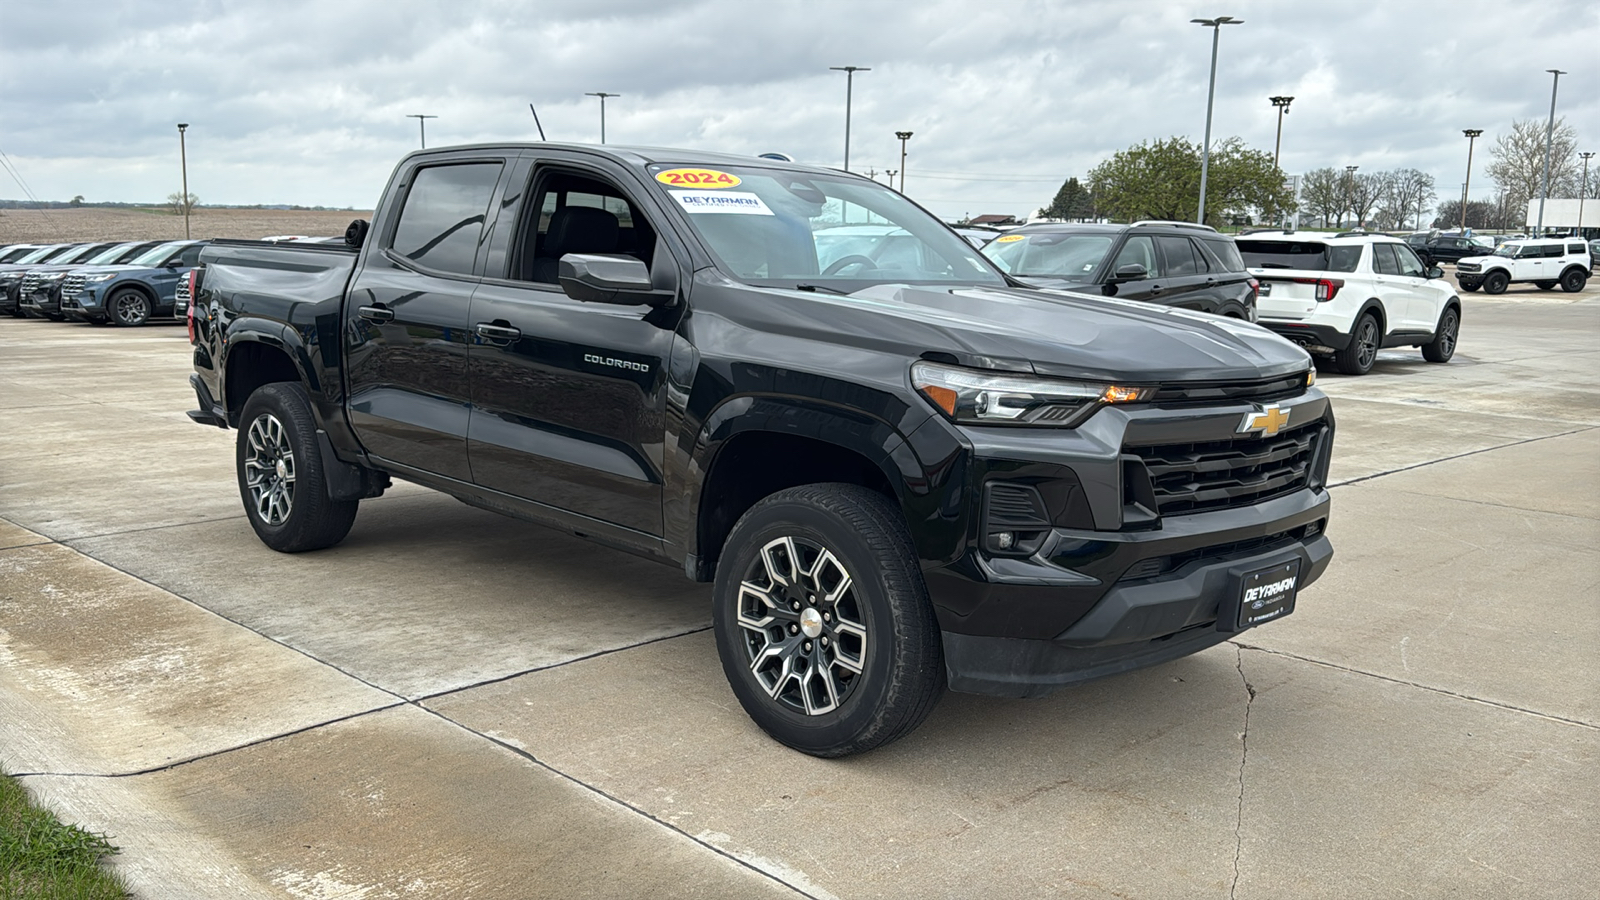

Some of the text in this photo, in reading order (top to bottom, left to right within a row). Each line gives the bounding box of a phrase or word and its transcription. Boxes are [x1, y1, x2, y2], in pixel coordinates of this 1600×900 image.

[666, 172, 734, 184] 2024
[682, 196, 759, 206] DEYARMAN
[584, 354, 649, 372] COLORADO
[1244, 576, 1296, 603] DEYARMAN
